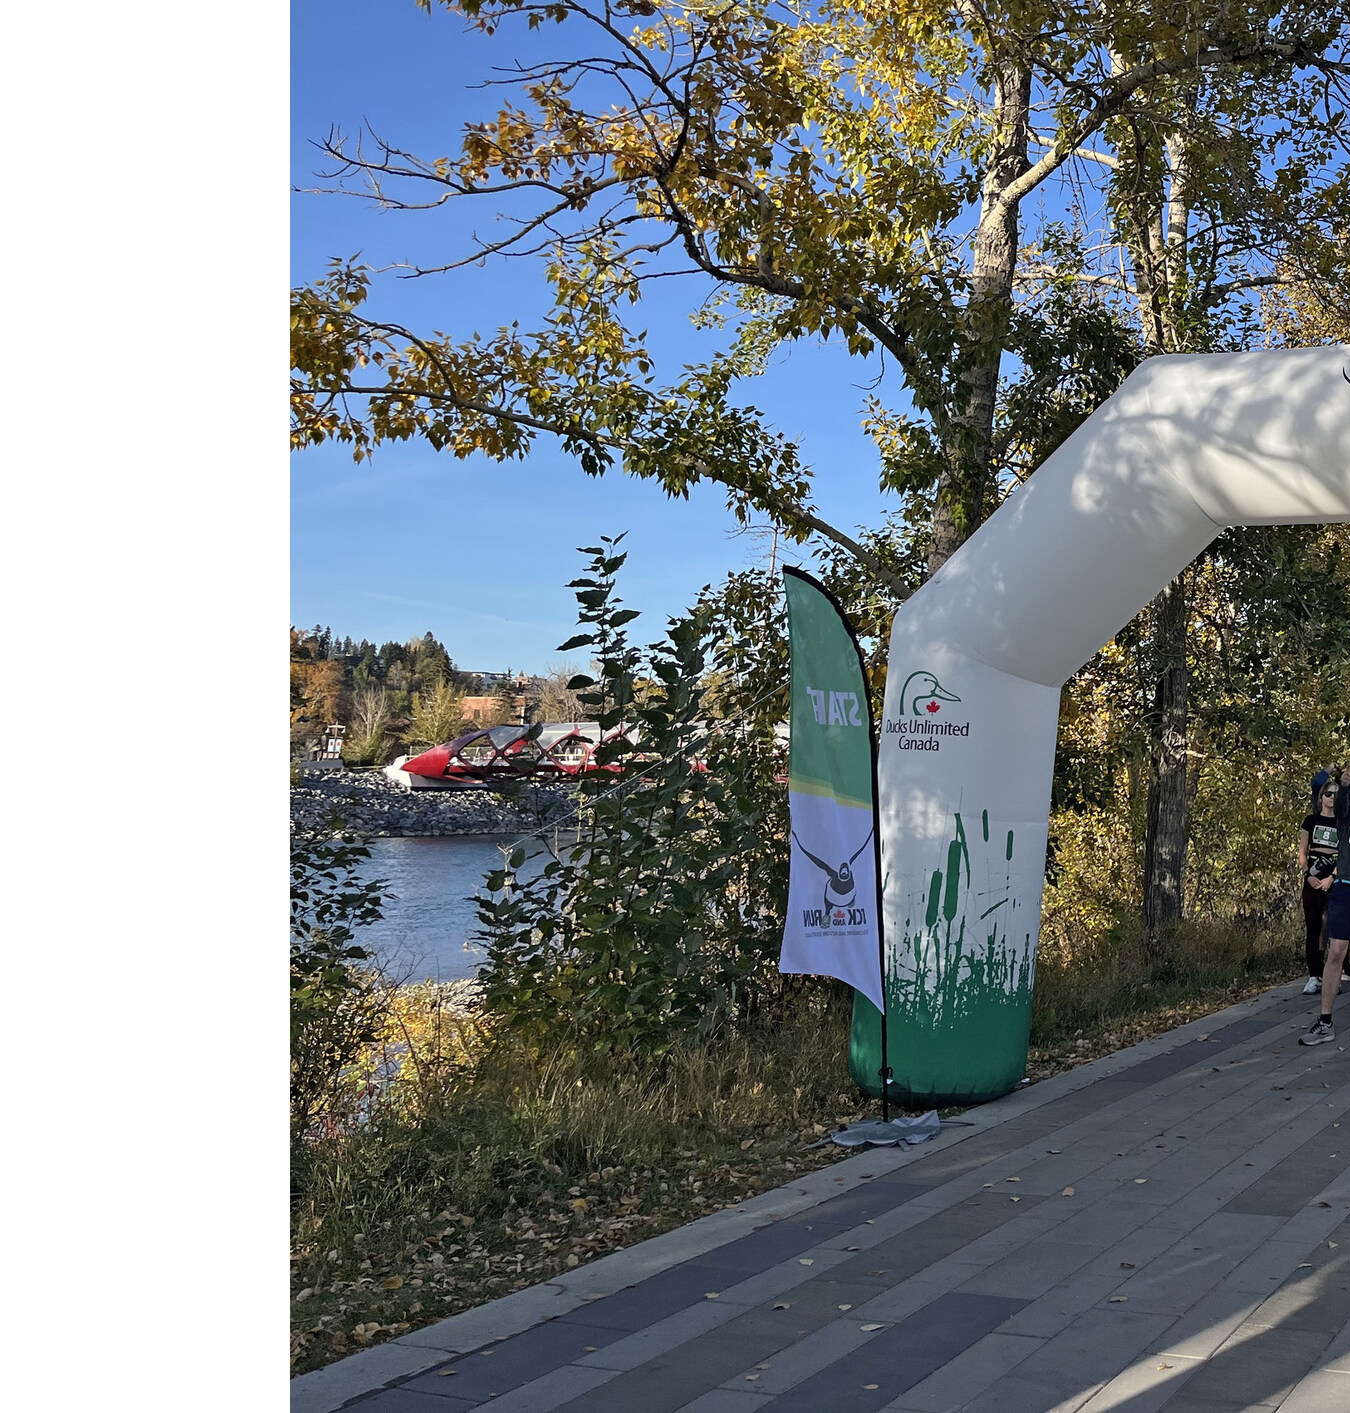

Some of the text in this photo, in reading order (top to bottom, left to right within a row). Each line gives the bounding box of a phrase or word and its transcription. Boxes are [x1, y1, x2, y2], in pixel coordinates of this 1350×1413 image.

[886, 719, 970, 737] Ducks Unlimited
[898, 735, 940, 751] Canada
[1322, 831, 1330, 840] 8
